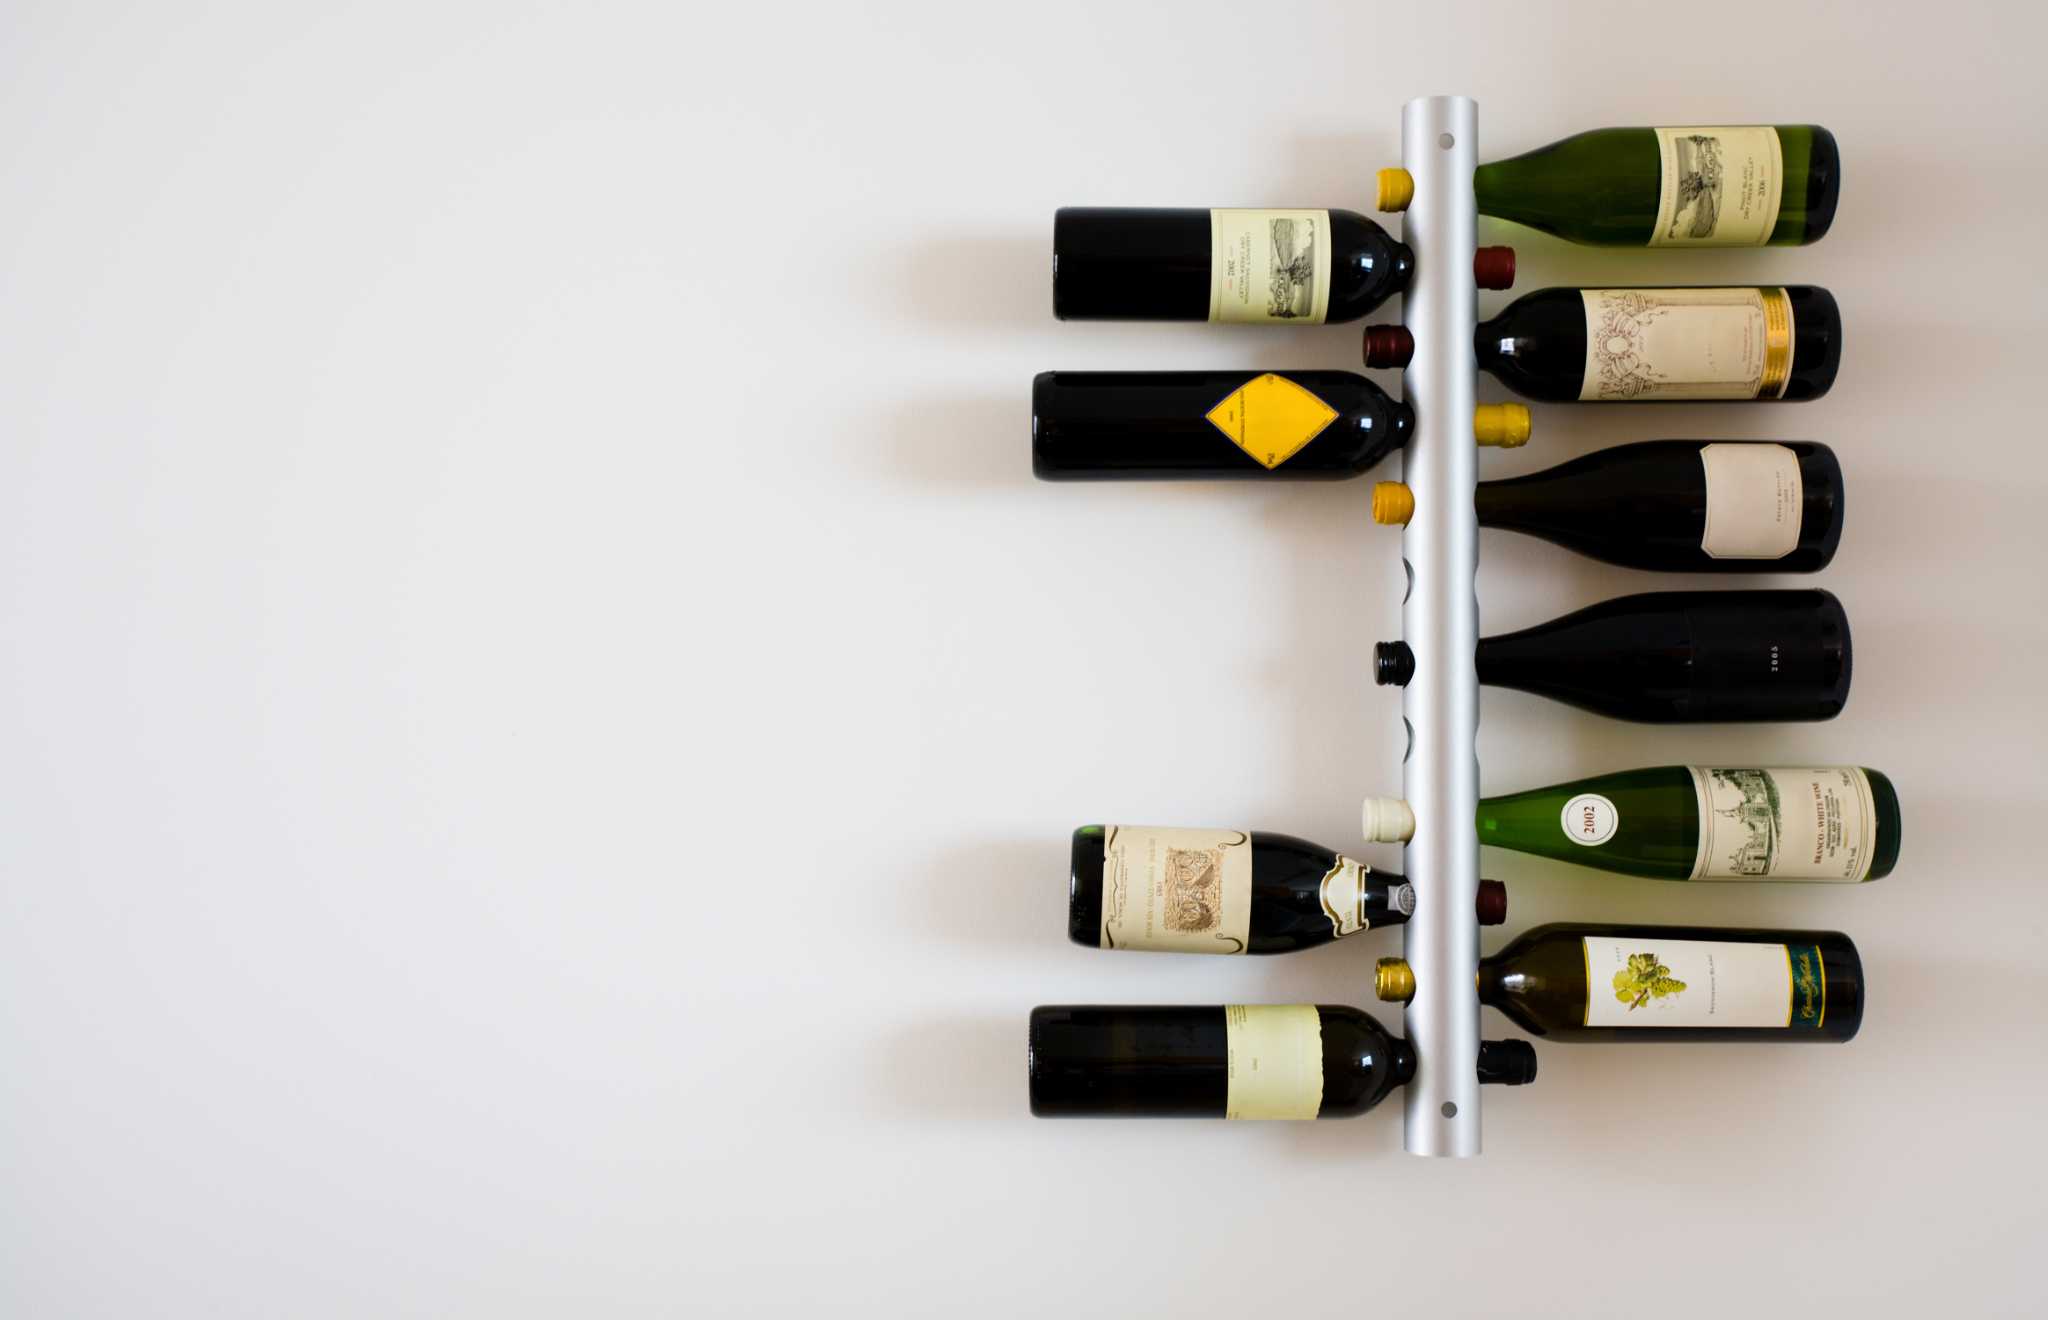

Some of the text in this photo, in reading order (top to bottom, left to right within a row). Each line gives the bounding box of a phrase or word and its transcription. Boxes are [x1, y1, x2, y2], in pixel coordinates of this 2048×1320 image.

[1812, 782, 1822, 800] WINE
[1583, 806, 1595, 834] 2002
[1816, 801, 1825, 828] WHITE
[1813, 833, 1825, 864] BRANCO
